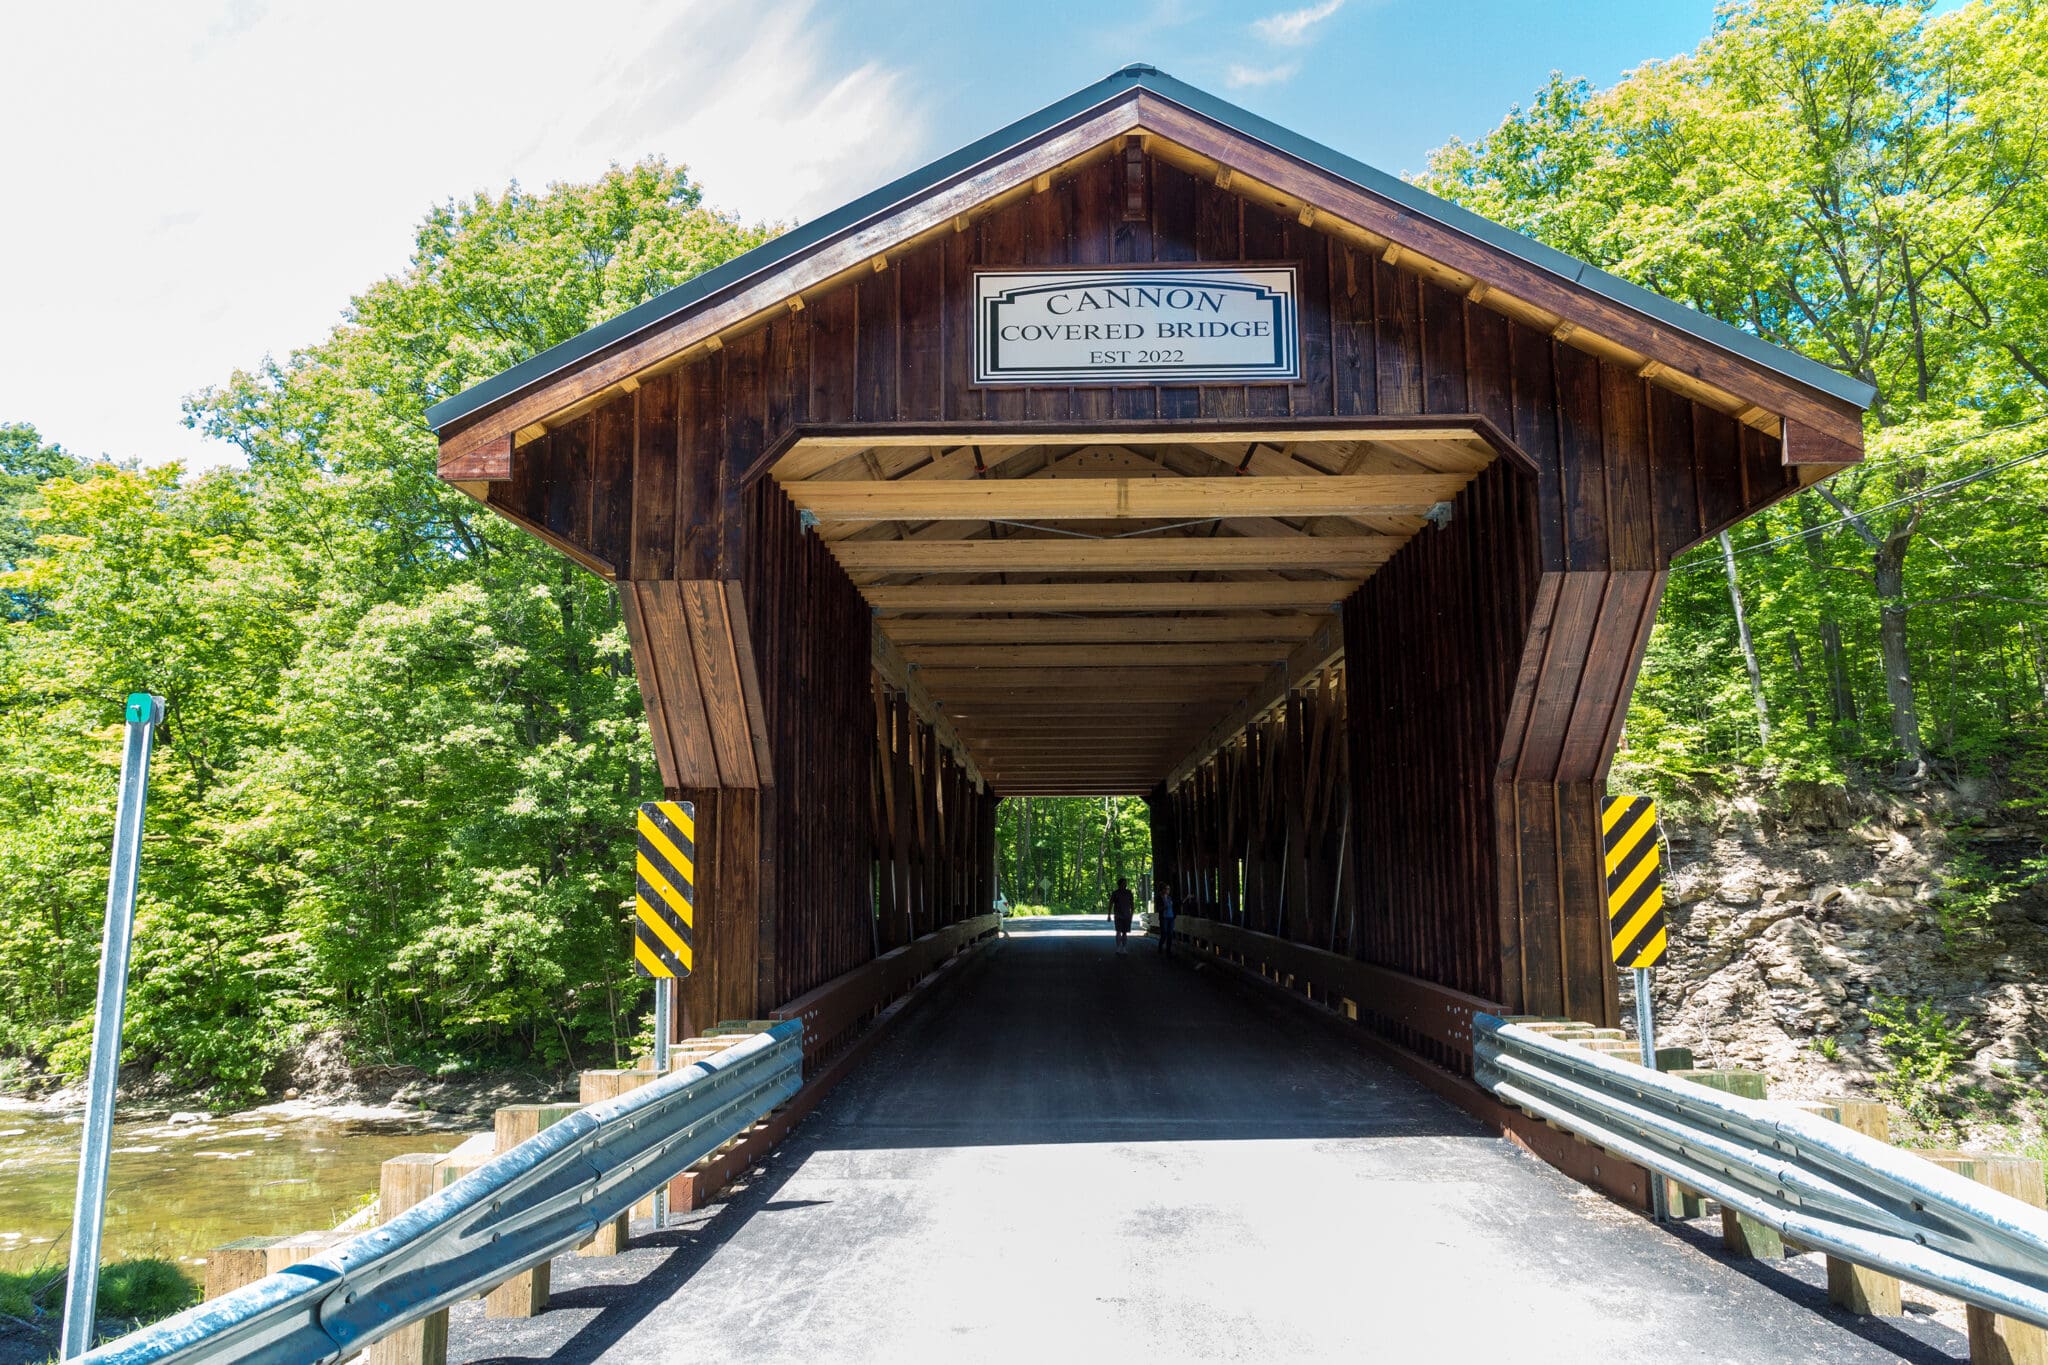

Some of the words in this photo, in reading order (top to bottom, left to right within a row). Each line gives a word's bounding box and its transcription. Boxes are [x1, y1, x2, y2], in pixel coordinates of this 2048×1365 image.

[1046, 287, 1228, 315] CANNON
[1000, 323, 1144, 342] COVERED
[1156, 320, 1271, 339] BRIDGE
[1089, 350, 1132, 364] EST
[1138, 349, 1185, 363] 2022
